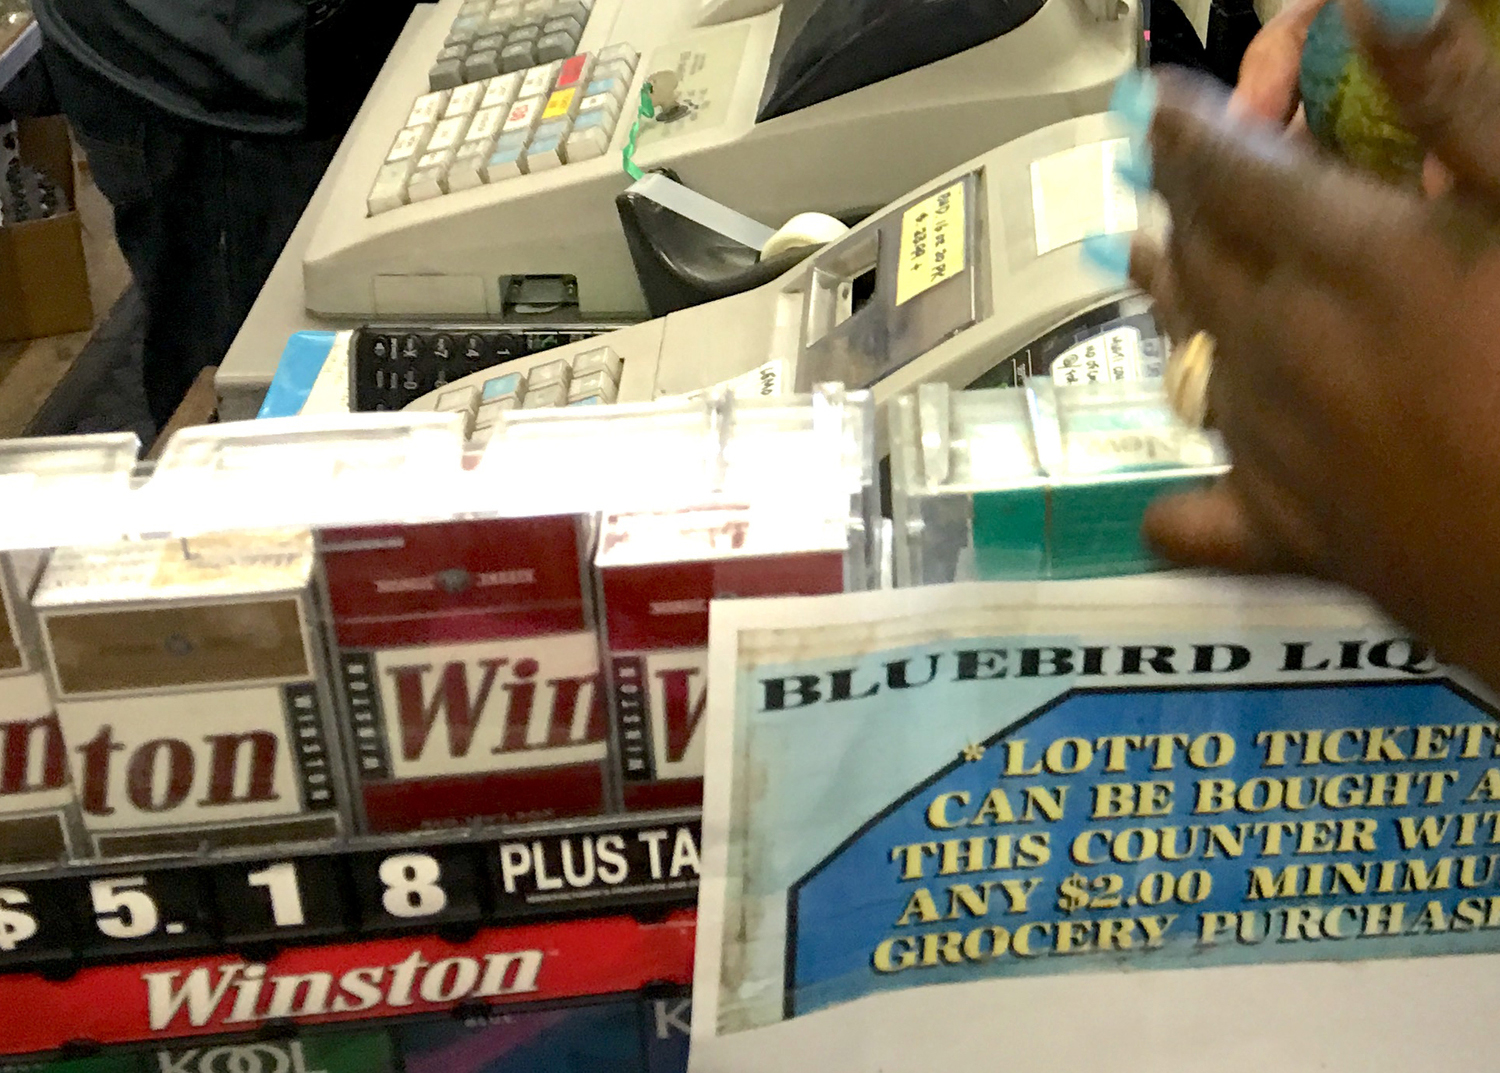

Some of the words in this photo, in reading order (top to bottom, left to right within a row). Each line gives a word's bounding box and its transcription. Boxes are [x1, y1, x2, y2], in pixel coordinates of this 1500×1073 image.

[385, 656, 606, 763] Win
[759, 642, 1252, 713] BLUEBIRD
[1277, 637, 1437, 676] LIQ
[73, 723, 282, 817] ton
[1003, 731, 1237, 778] LOTTO
[926, 784, 1070, 830] CAN
[1090, 780, 1175, 820] BE
[1195, 769, 1459, 816] BOUGHT
[248, 861, 305, 927] 1
[379, 852, 448, 918] 8
[500, 833, 629, 894] PLUS
[889, 832, 1051, 882] THIS
[1070, 816, 1378, 865] COUNTER
[895, 877, 1044, 926] ANY
[1056, 868, 1213, 916] $2.00
[871, 914, 1179, 975] GROCERY
[140, 945, 548, 1032] Winston
